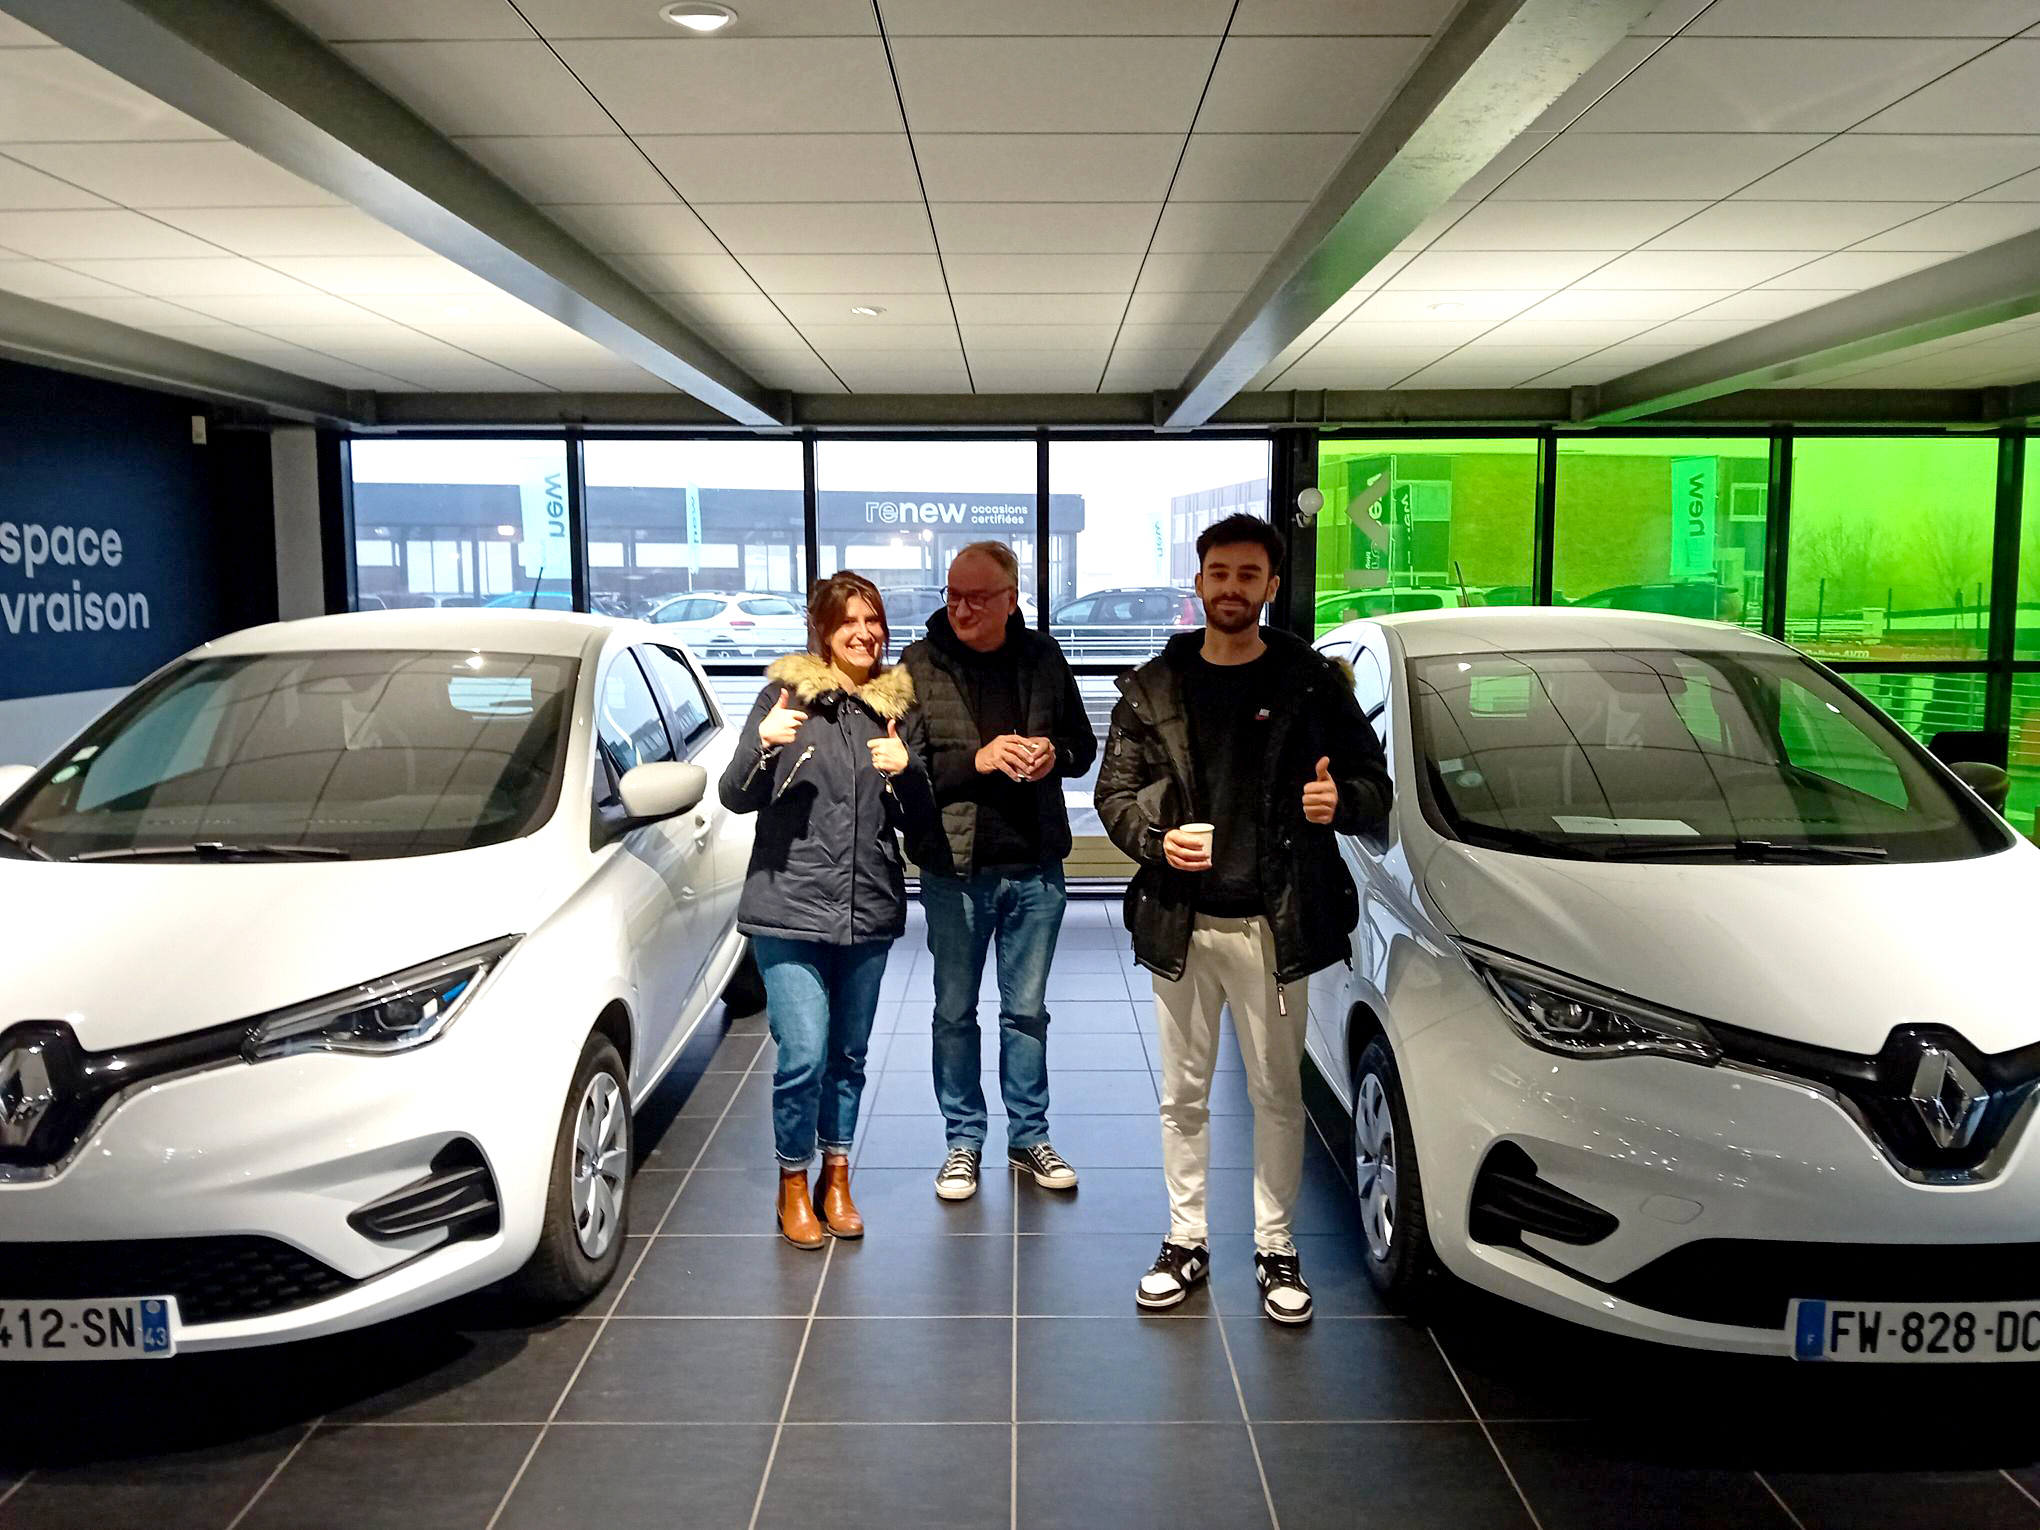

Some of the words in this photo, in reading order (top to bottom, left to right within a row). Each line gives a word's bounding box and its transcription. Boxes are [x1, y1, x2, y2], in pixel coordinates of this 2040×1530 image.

[865, 501, 967, 524] renew
[971, 503, 1028, 514] occasions
[971, 514, 1025, 525] certifiées
[0, 521, 123, 578] space
[0, 579, 151, 634] vraison
[143, 1327, 168, 1347] 43
[1830, 1310, 2040, 1353] FW-828-DC
